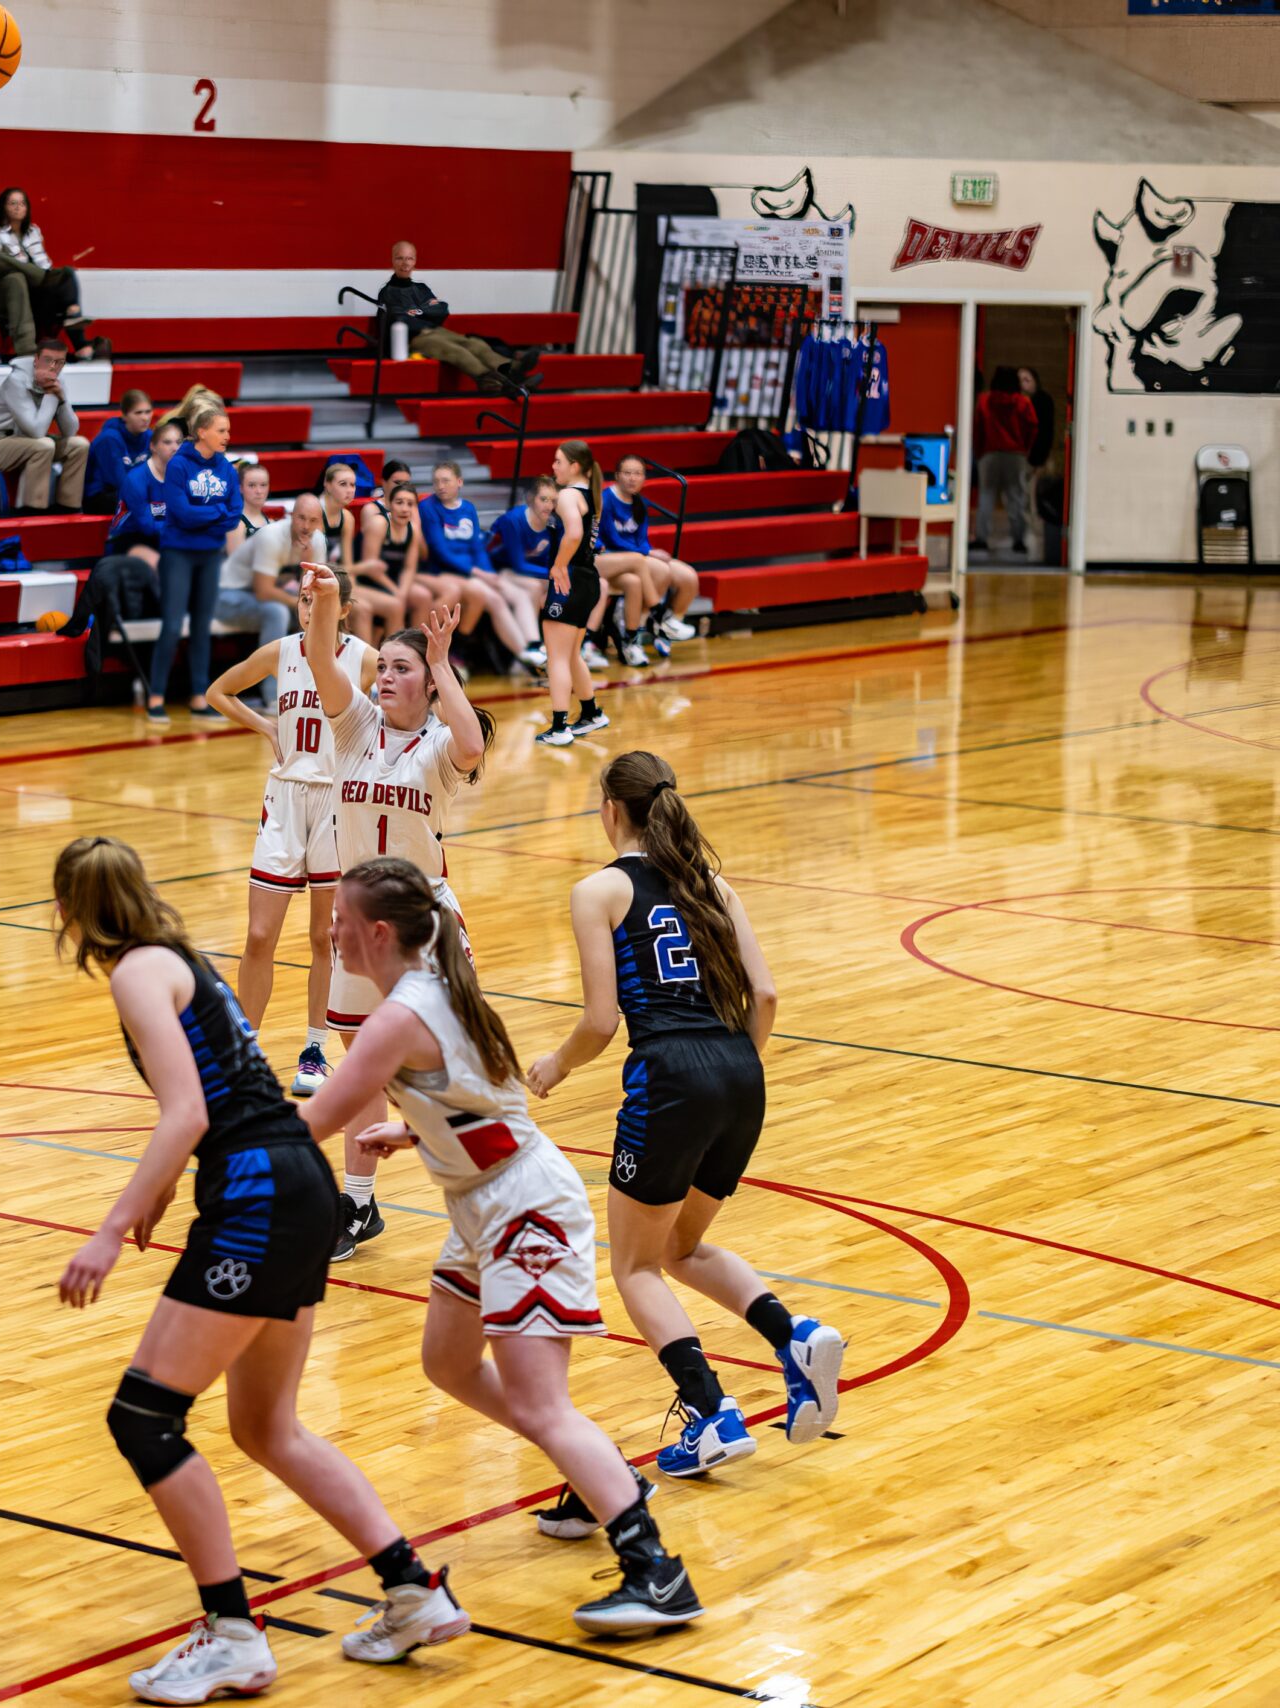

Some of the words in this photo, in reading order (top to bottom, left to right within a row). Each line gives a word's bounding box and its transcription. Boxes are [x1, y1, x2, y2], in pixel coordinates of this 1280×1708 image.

[194, 78, 216, 132] 2
[296, 717, 322, 754] 10
[341, 780, 369, 804] RED
[372, 782, 433, 817] DEVILS
[377, 814, 388, 856] 1
[648, 904, 700, 984] 2
